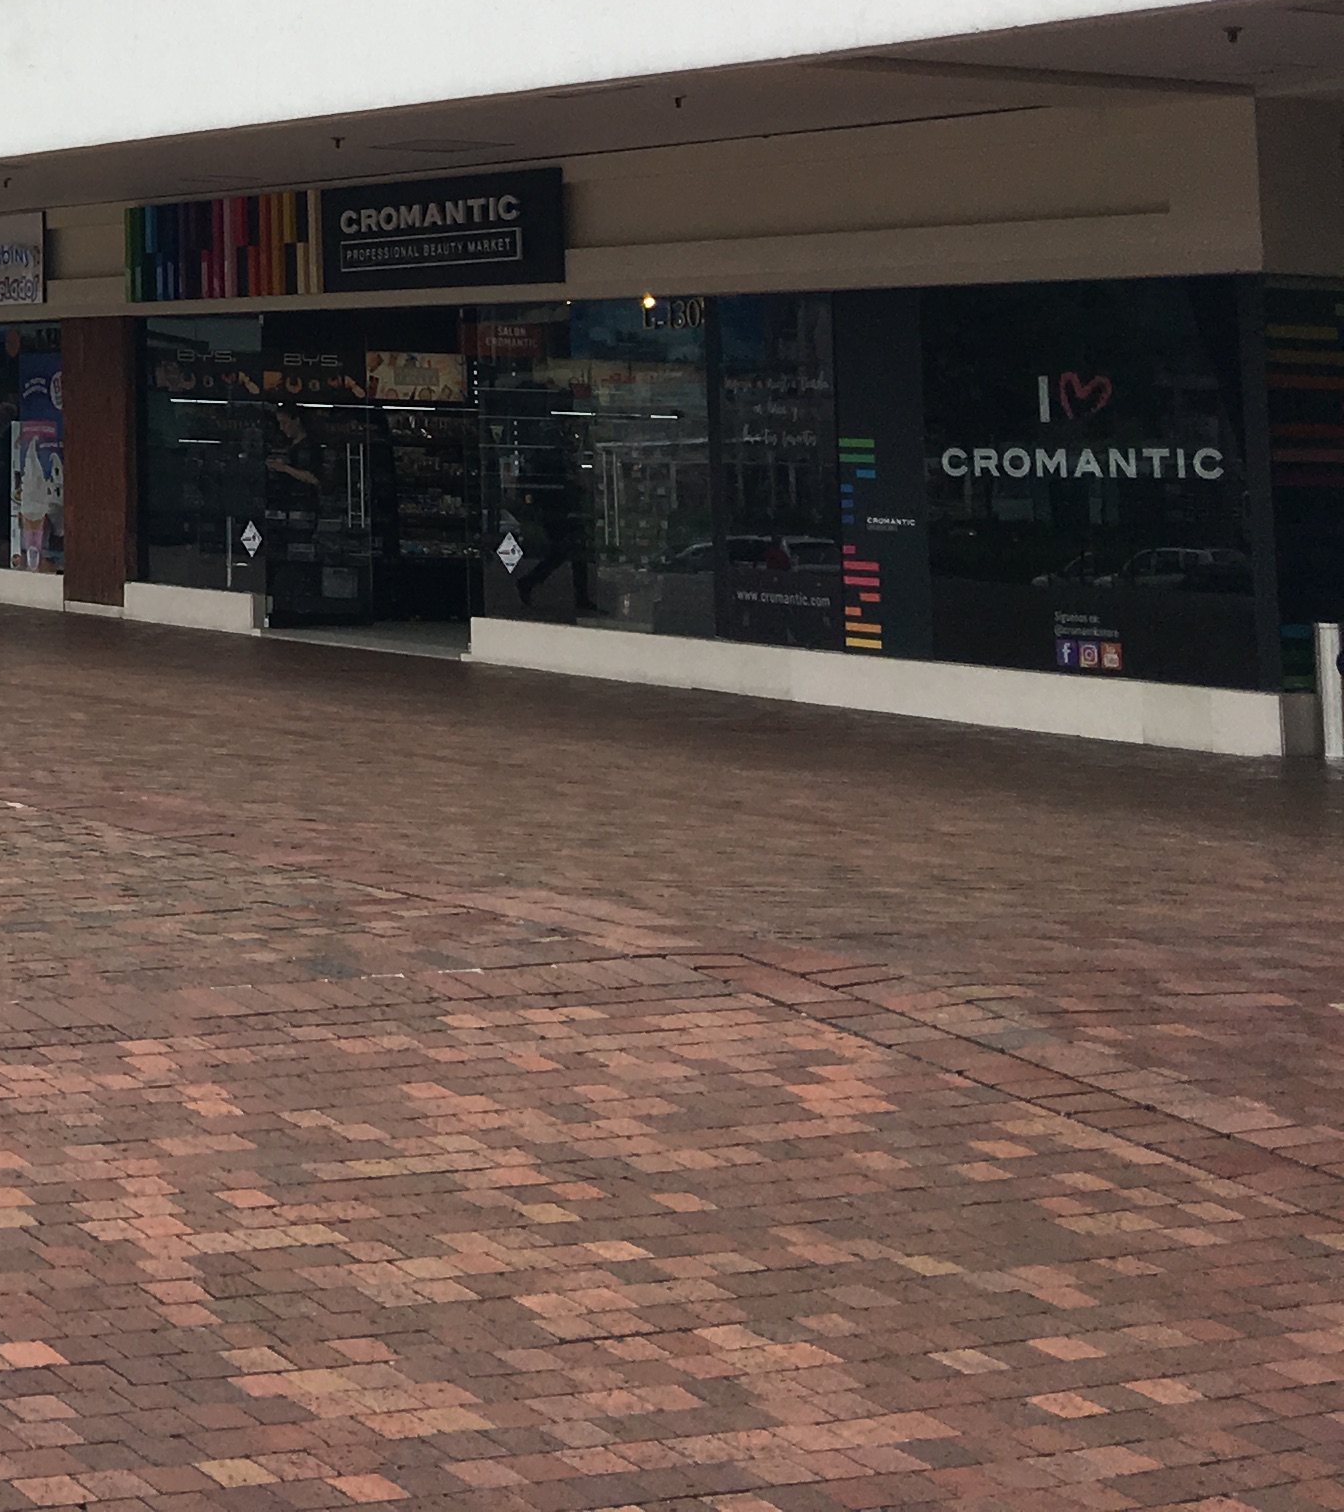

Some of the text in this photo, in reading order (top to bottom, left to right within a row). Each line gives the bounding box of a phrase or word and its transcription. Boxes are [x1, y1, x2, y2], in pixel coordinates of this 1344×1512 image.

[340, 194, 521, 235] CROMANTIC
[346, 237, 512, 262] PROFESSIONAL BEAUTY MARKET
[497, 324, 527, 337] SALON
[941, 446, 1225, 480] CROMANTIC
[866, 516, 917, 527] CROMANTIC
[736, 589, 831, 607] www.cromantic.com
